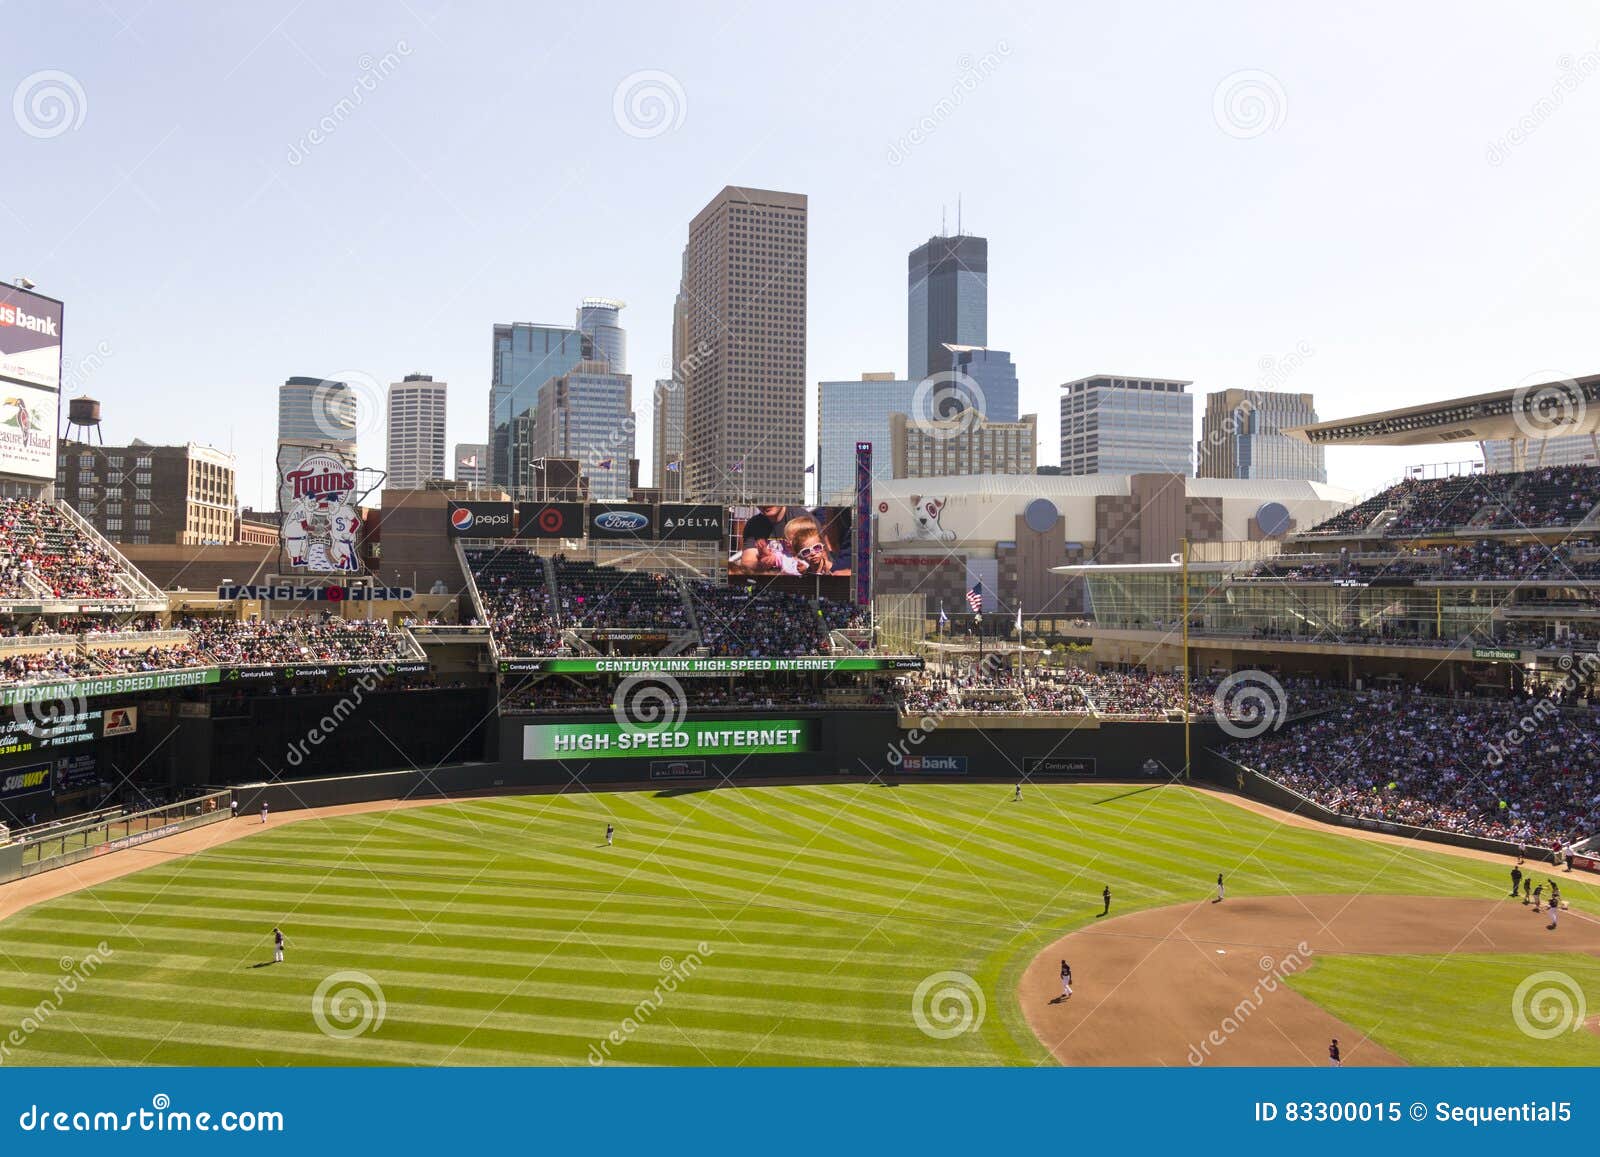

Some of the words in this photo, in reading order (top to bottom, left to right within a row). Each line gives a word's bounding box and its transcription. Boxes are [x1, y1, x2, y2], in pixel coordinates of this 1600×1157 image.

[29, 432, 51, 449] Island
[287, 467, 355, 500] Twins
[475, 513, 509, 525] pepsi
[605, 513, 637, 529] Ford
[678, 518, 719, 527] DELTA
[217, 585, 324, 601] TARGET
[349, 586, 416, 601] FIELD
[595, 661, 690, 672] CENTURYLINK
[694, 660, 772, 671] HIGH-SPEED
[776, 659, 836, 670] INTERNET
[241, 671, 275, 679] CenturyLink
[295, 669, 328, 677] CenturyLink
[81, 679, 153, 696] HIGH-SPEED
[157, 671, 208, 686] INTERNET
[554, 732, 690, 751] HIGH-SPEED
[697, 729, 801, 747] INTERNET
[903, 757, 957, 769] usbank
[1045, 762, 1084, 770] CenturyLink
[2, 769, 49, 791] SUBWAY
